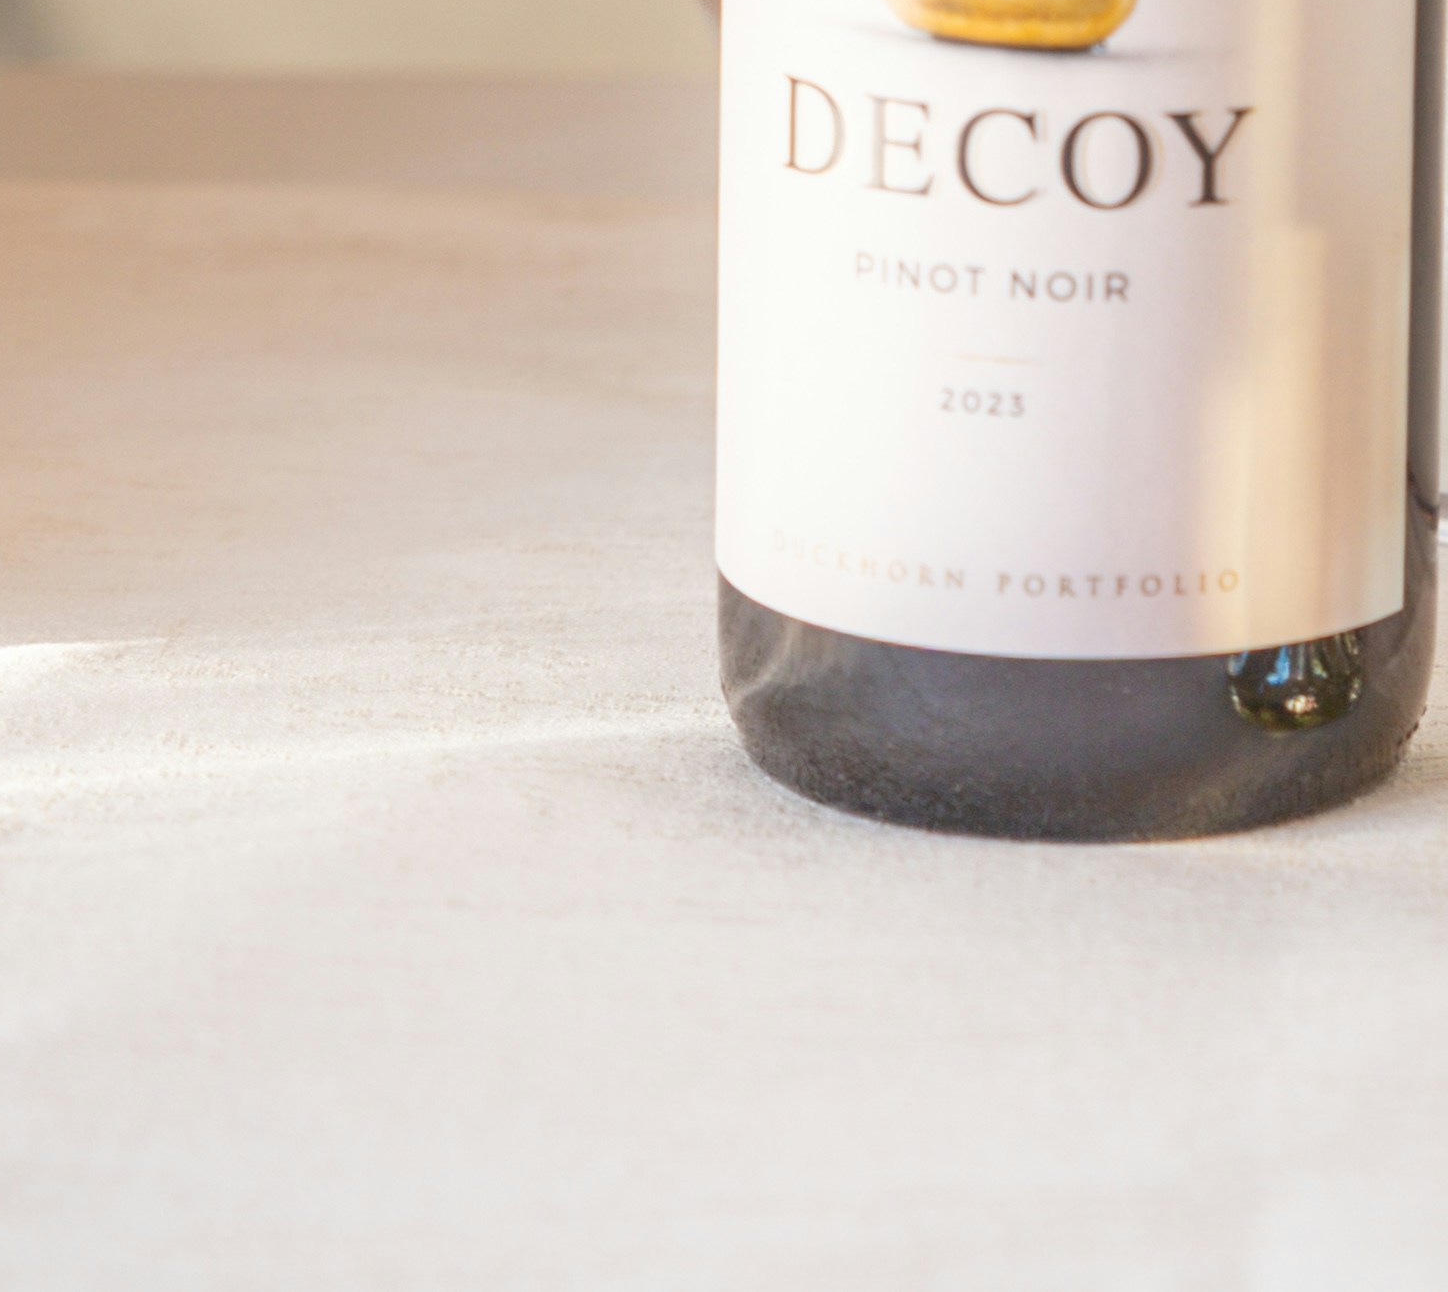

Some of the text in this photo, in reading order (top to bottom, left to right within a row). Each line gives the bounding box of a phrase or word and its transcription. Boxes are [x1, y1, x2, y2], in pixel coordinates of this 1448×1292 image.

[781, 73, 1258, 212] DECOY
[852, 249, 1132, 304] PINOT NOIR
[938, 385, 1028, 421] 2023
[771, 527, 1241, 600] DUCKHORN PORTFOLIO
